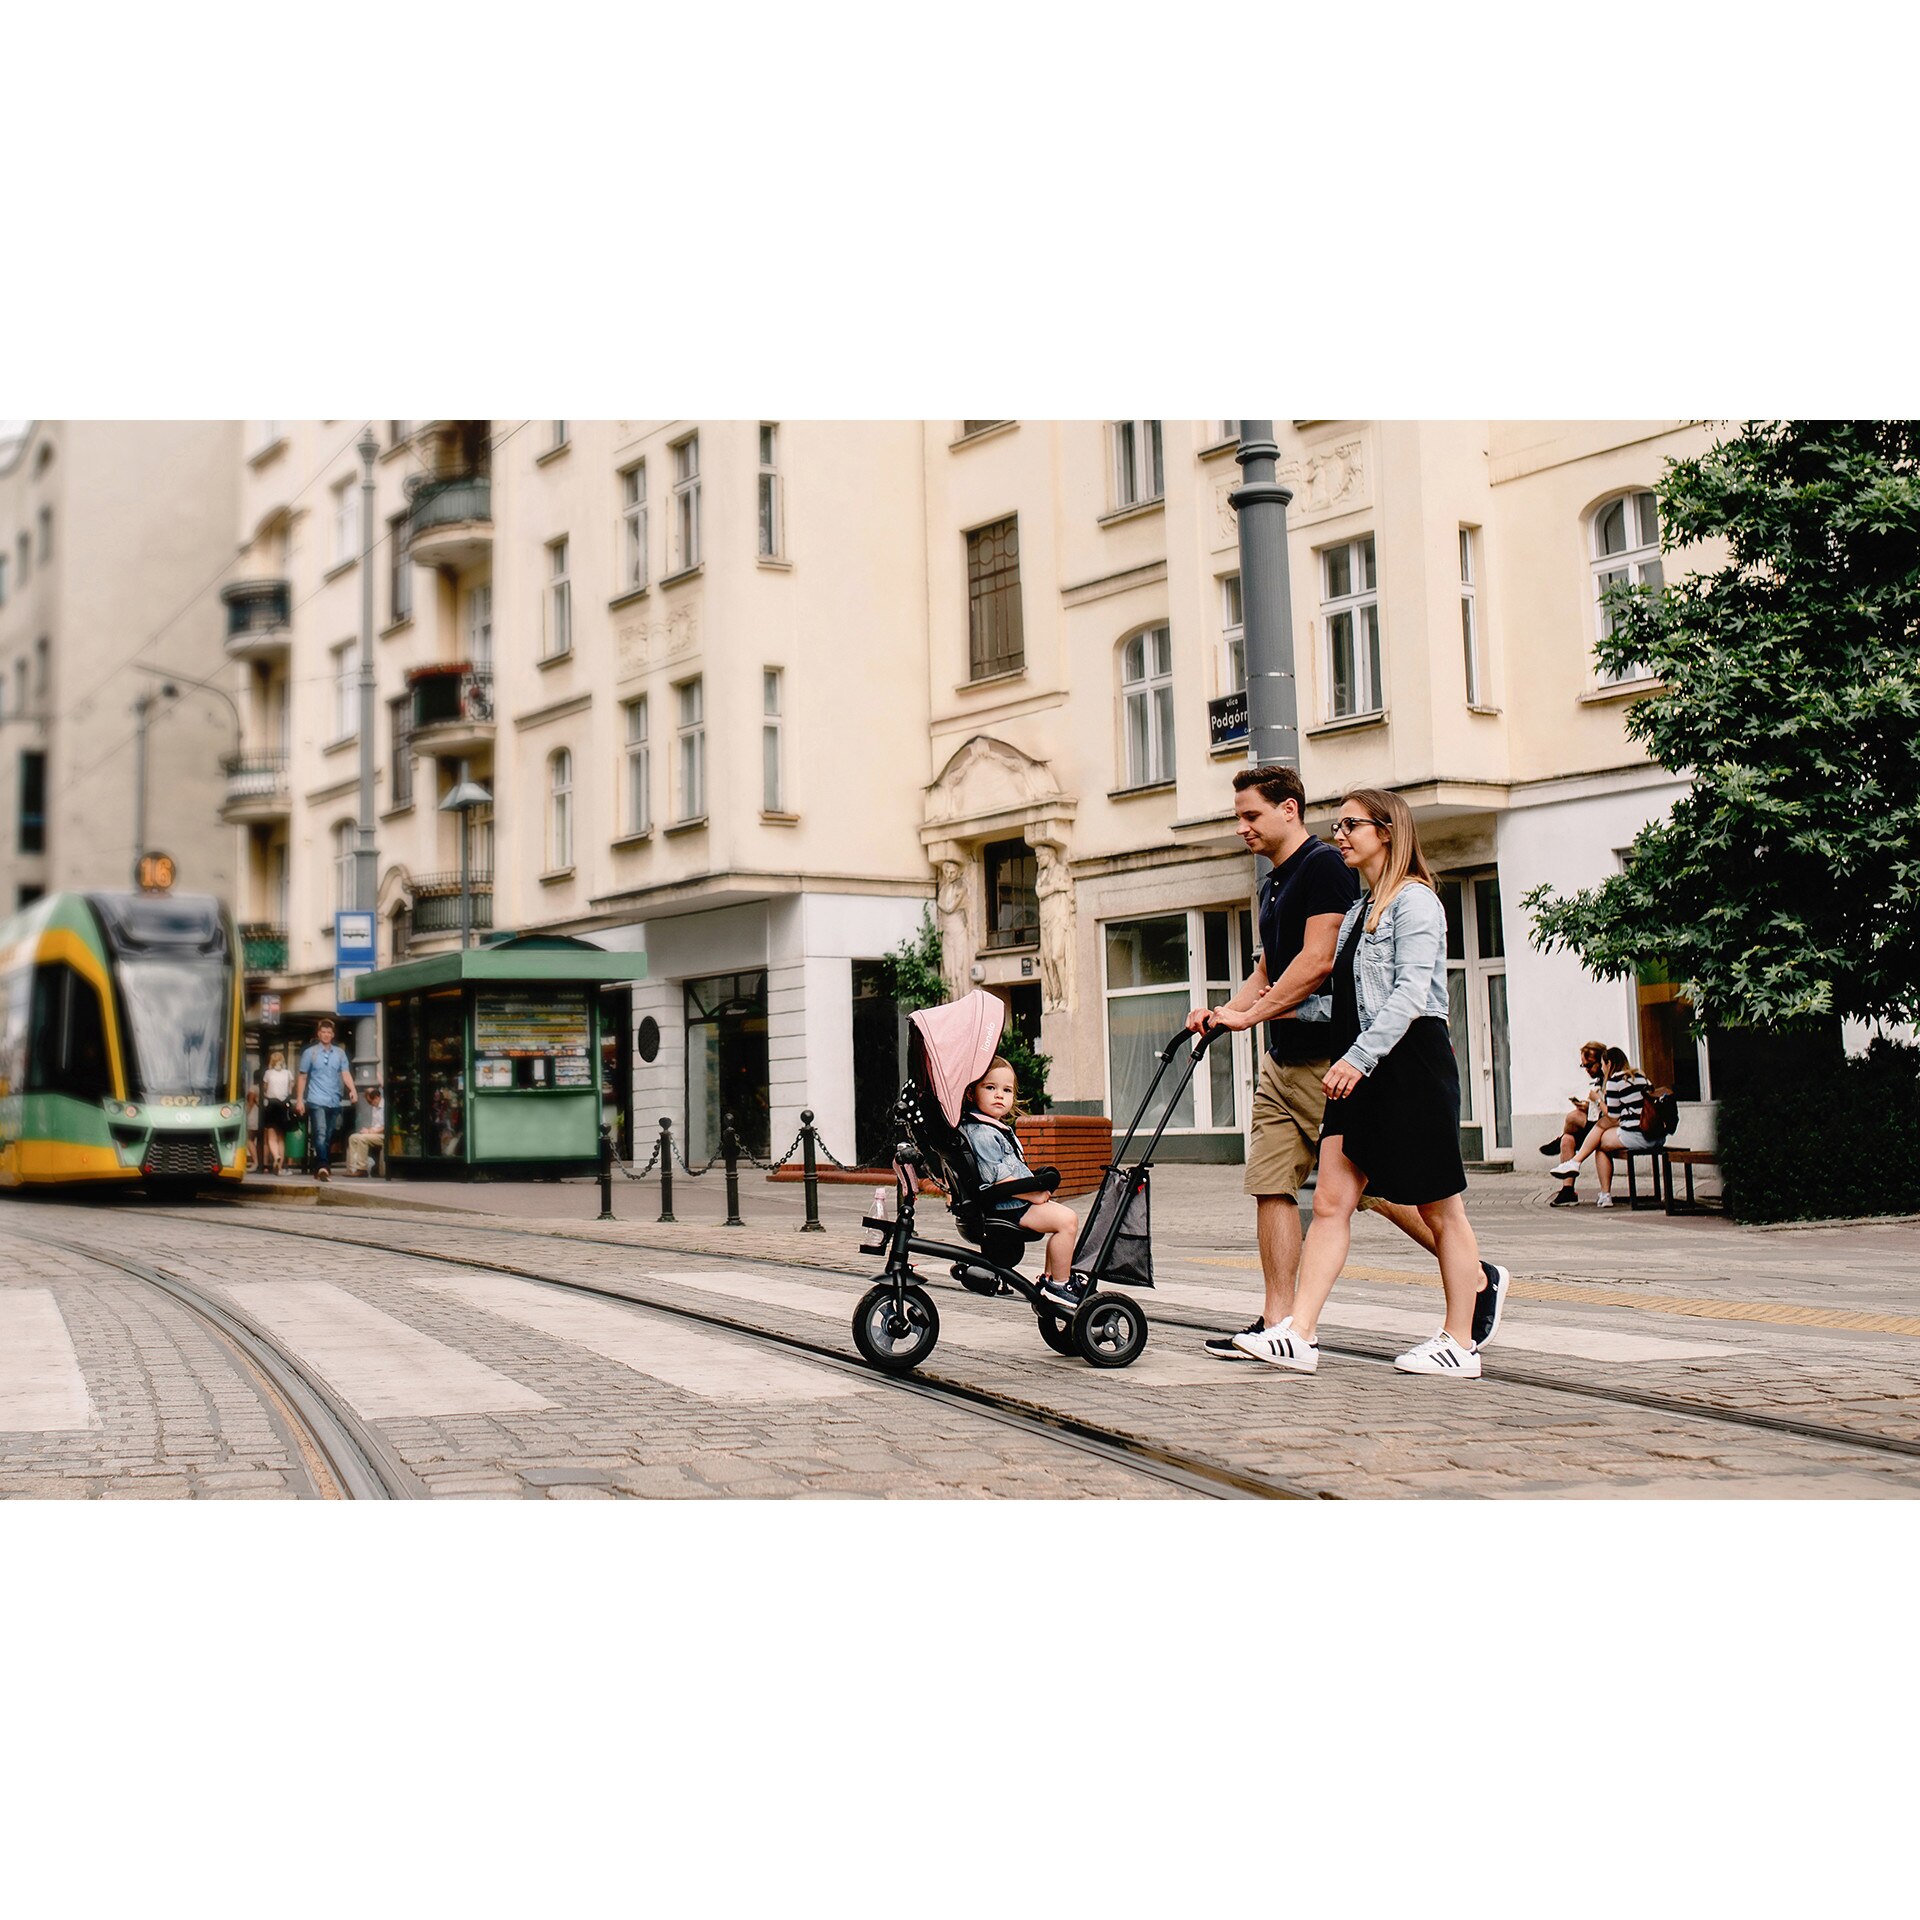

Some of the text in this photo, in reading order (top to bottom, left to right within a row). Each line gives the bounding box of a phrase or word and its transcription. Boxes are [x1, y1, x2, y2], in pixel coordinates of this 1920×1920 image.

[1225, 698, 1238, 707] ulica
[142, 857, 171, 887] 16
[981, 1022, 996, 1052] lionelo
